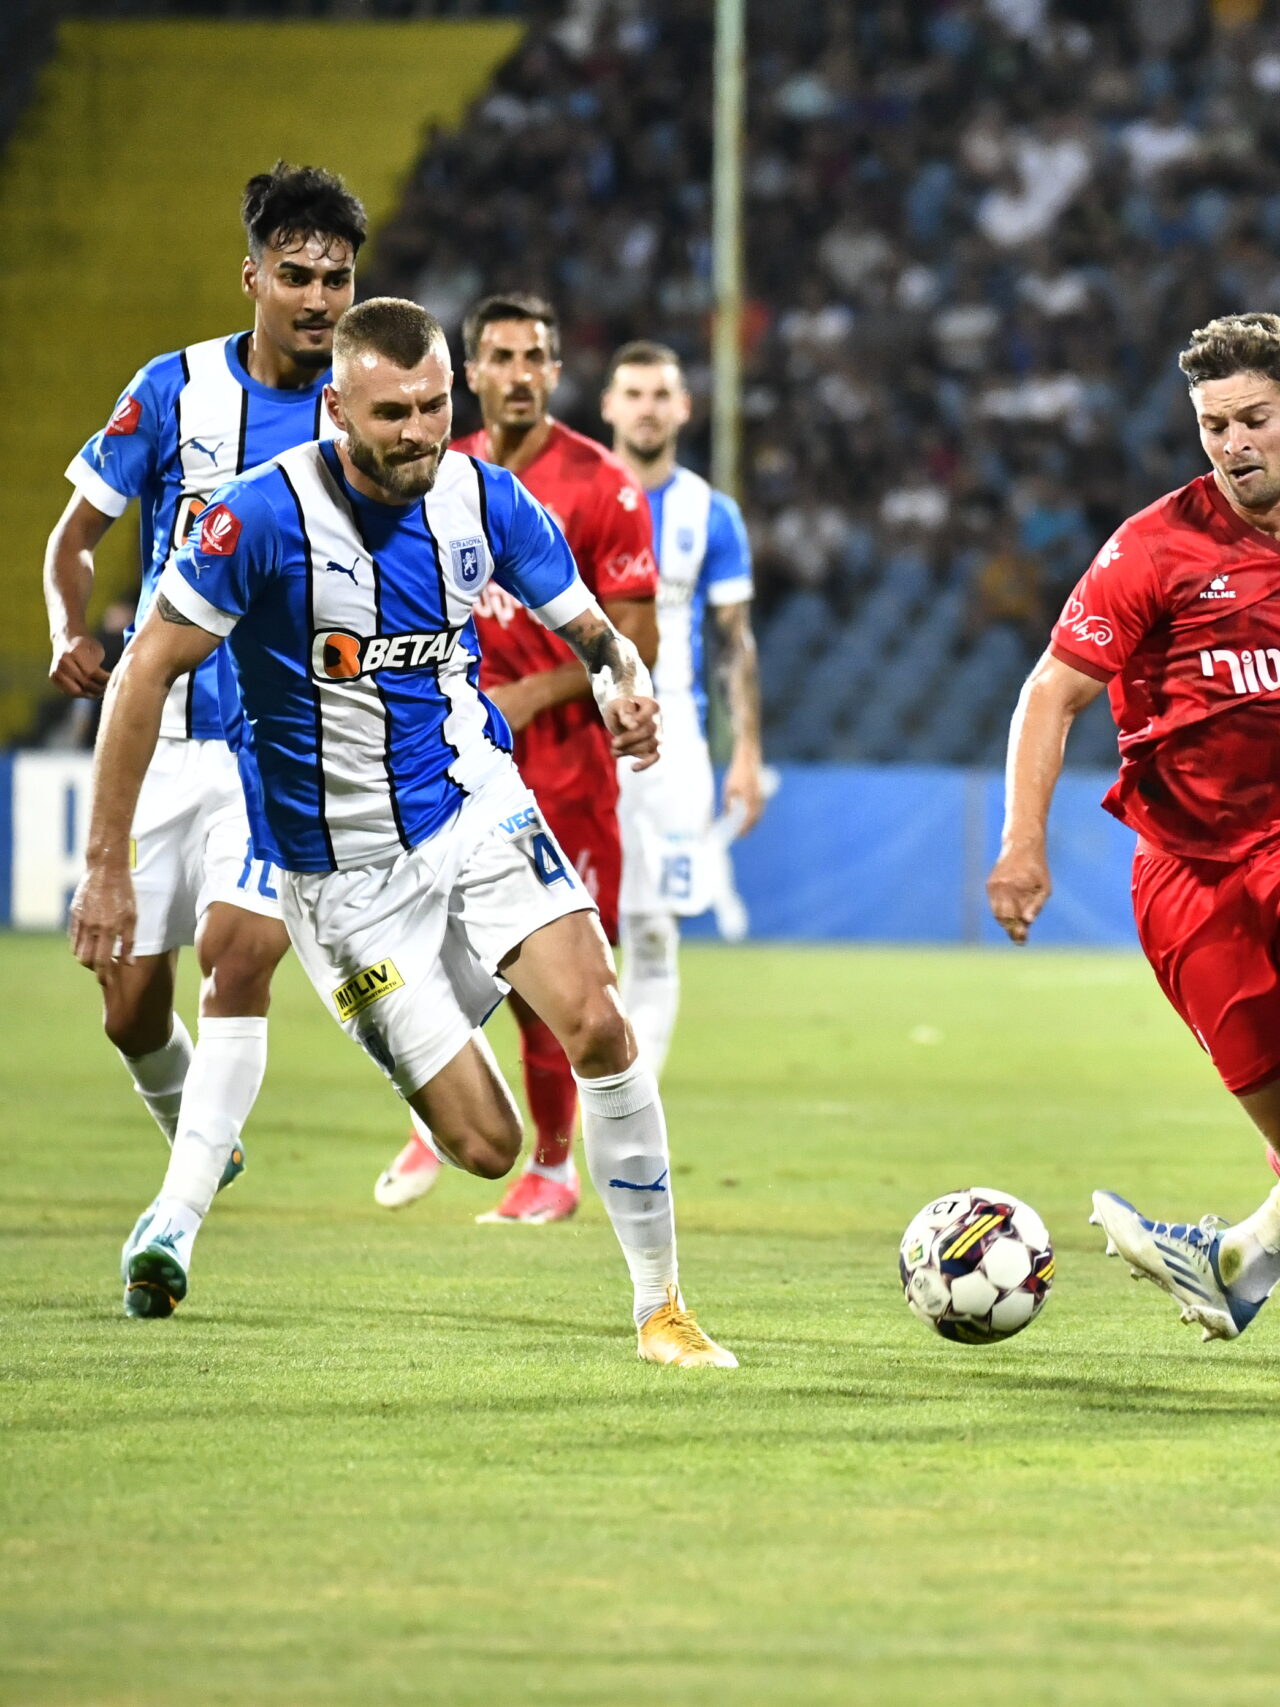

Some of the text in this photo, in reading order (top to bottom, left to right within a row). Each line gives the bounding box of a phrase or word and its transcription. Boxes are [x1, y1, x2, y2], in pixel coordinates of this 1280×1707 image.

[451, 538, 482, 549] CRAIOVA
[1199, 590, 1237, 599] KELME
[532, 832, 576, 889] 4
[660, 855, 691, 899] 19
